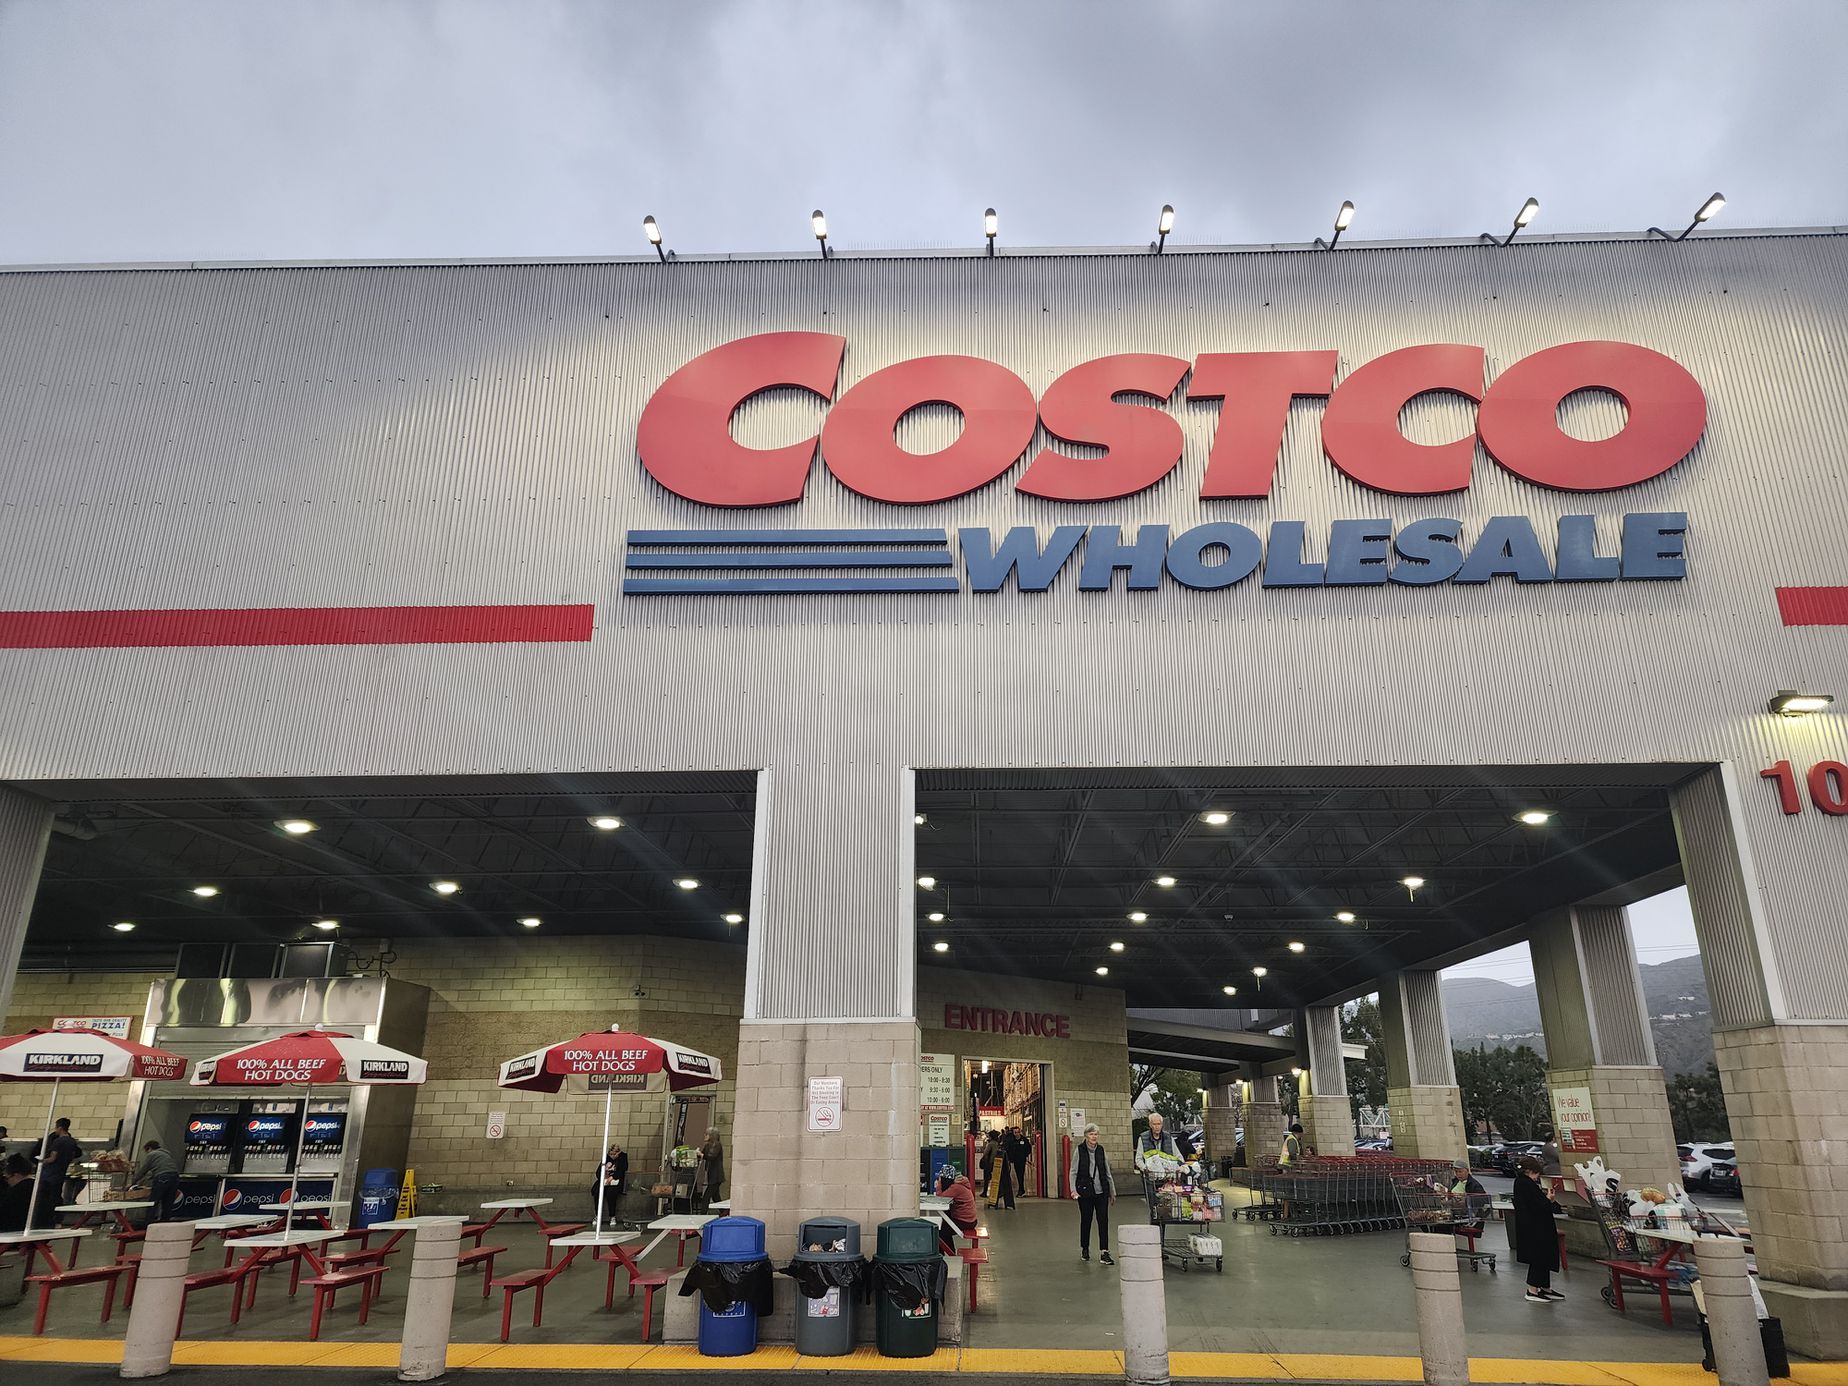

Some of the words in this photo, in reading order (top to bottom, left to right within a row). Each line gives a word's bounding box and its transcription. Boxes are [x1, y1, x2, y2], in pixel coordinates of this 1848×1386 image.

[636, 331, 1707, 507] COSTCO
[957, 512, 1688, 592] WHOLESALE
[944, 1003, 1070, 1039] ENTRANCE
[28, 1054, 101, 1066] KIRKLAND
[141, 1055, 155, 1066] 100%
[155, 1056, 167, 1066] ALL
[167, 1057, 180, 1067] BEEF
[564, 1050, 593, 1060] 100%
[597, 1050, 618, 1060] ALL
[621, 1050, 648, 1060] BEEF
[678, 1053, 708, 1067] KIRKLAND
[236, 1058, 267, 1069] 100%
[272, 1059, 296, 1069] ALL
[297, 1059, 327, 1069] BEEF
[363, 1061, 407, 1072] KIRKLAND
[510, 1057, 536, 1072] KIRKLAND
[573, 1061, 598, 1071] HOT
[601, 1061, 636, 1071] DOGS
[144, 1066, 158, 1076] HOT
[158, 1067, 174, 1077] DOGS
[244, 1070, 273, 1081] HOT
[274, 1070, 311, 1081] DOGS
[1566, 1094, 1580, 1108] value
[200, 1122, 222, 1132] pepsi
[259, 1121, 281, 1131] pepsi
[316, 1121, 338, 1131] pepsi
[184, 1193, 216, 1205] pepsi
[242, 1193, 274, 1205] pepsi
